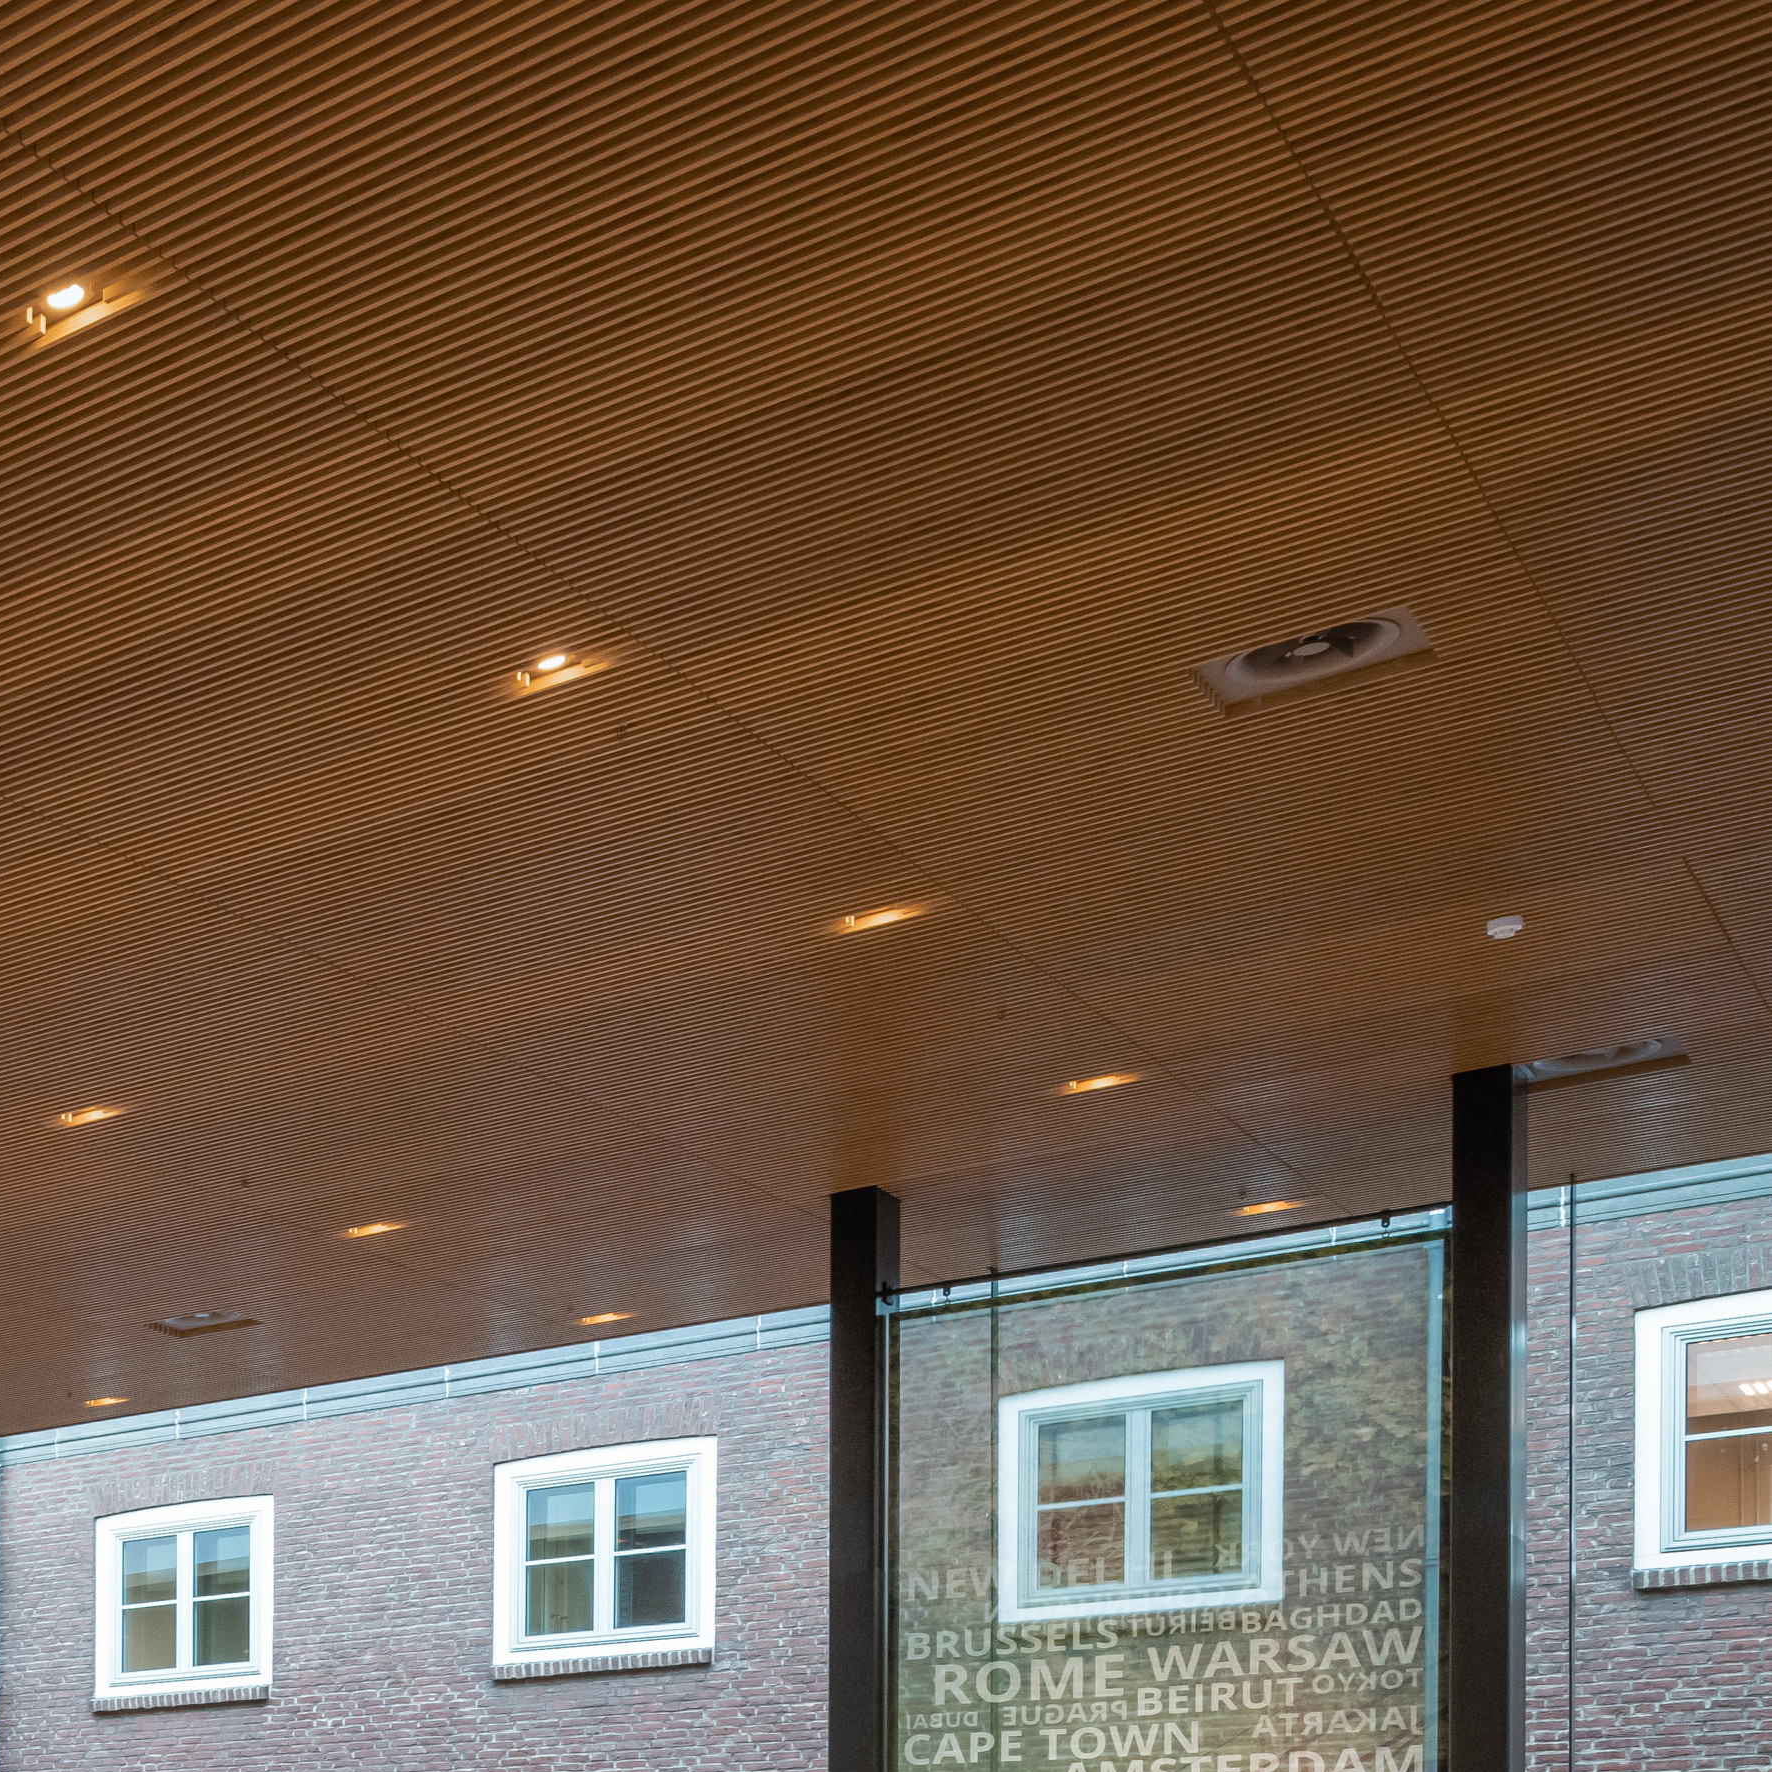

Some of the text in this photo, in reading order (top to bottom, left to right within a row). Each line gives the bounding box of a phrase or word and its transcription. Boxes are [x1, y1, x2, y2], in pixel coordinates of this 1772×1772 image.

[1241, 1598, 1423, 1634] BAGHDAD
[906, 1619, 1119, 1661] BRUSSELS
[1147, 1625, 1423, 1682] WARSAW
[934, 1653, 1125, 1706] ROME
[1136, 1677, 1304, 1717] BEIRUT
[904, 1721, 1200, 1766] CAPE TOWN
